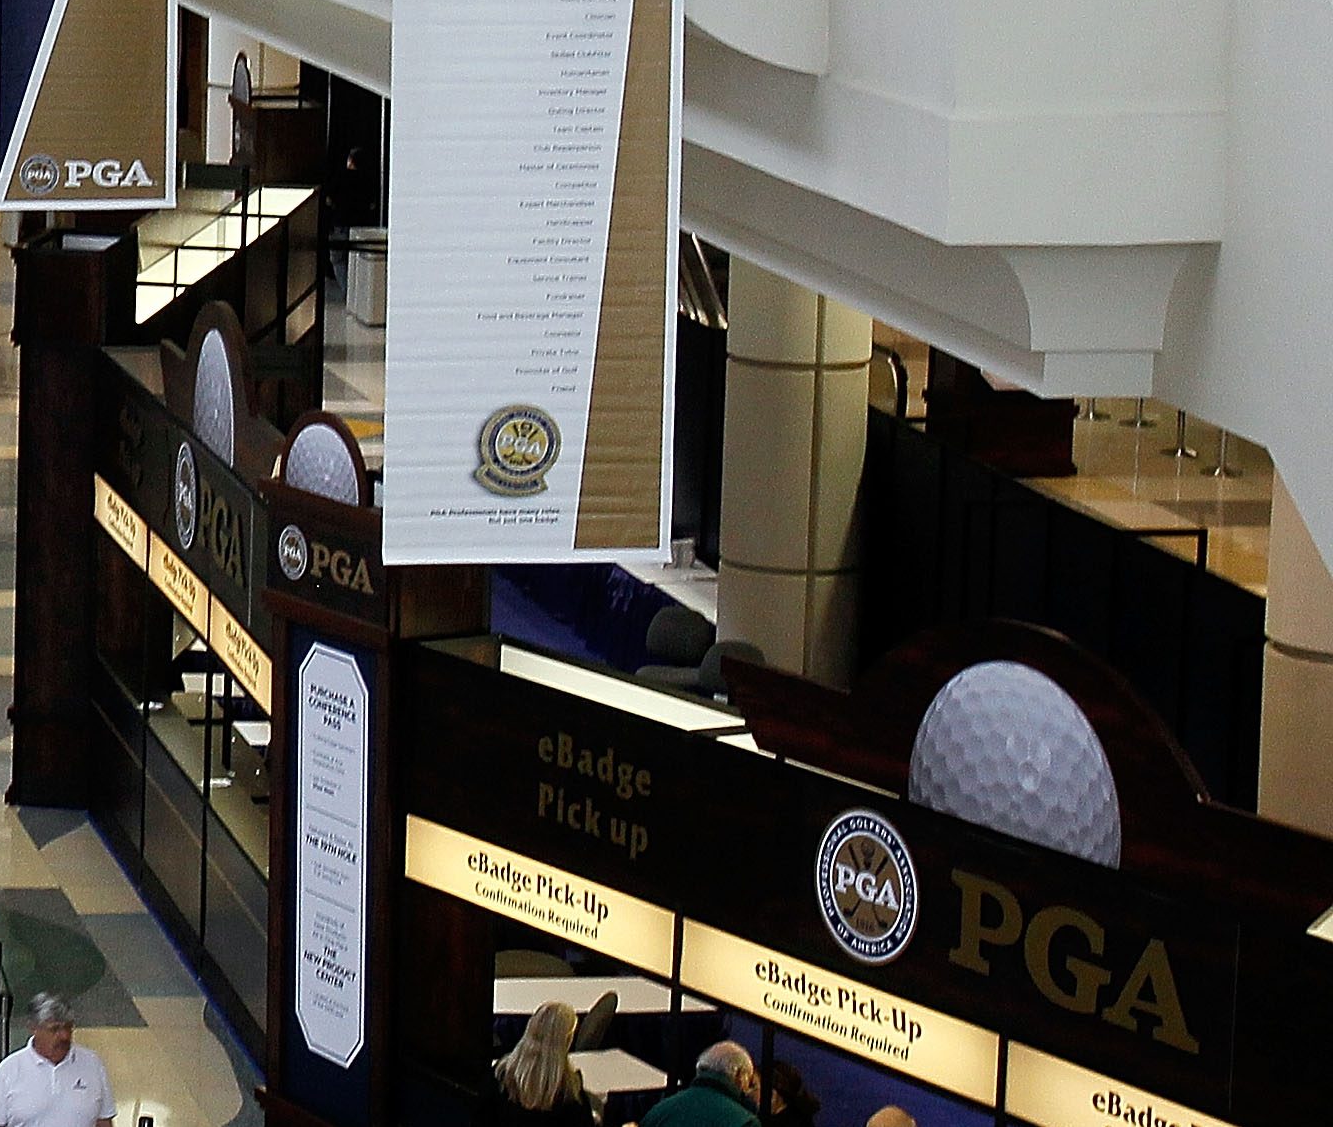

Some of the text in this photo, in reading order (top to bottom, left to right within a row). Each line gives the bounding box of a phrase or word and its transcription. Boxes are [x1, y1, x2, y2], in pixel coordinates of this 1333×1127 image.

[64, 159, 154, 188] PGA
[309, 541, 374, 595] PGA
[307, 696, 357, 724] CONFERENCE
[309, 683, 348, 706] PURCHASE
[537, 730, 653, 801] eBadge
[537, 780, 649, 860] Pick up
[467, 850, 609, 923] eBadge Pick-Up
[475, 880, 599, 940] Confirmation Required
[834, 862, 900, 913] PGA
[851, 938, 893, 954] AMERICA
[949, 867, 1200, 1055] PGA
[755, 959, 923, 1043] eBadge Pick-Up
[763, 991, 910, 1062] Confirmation Required
